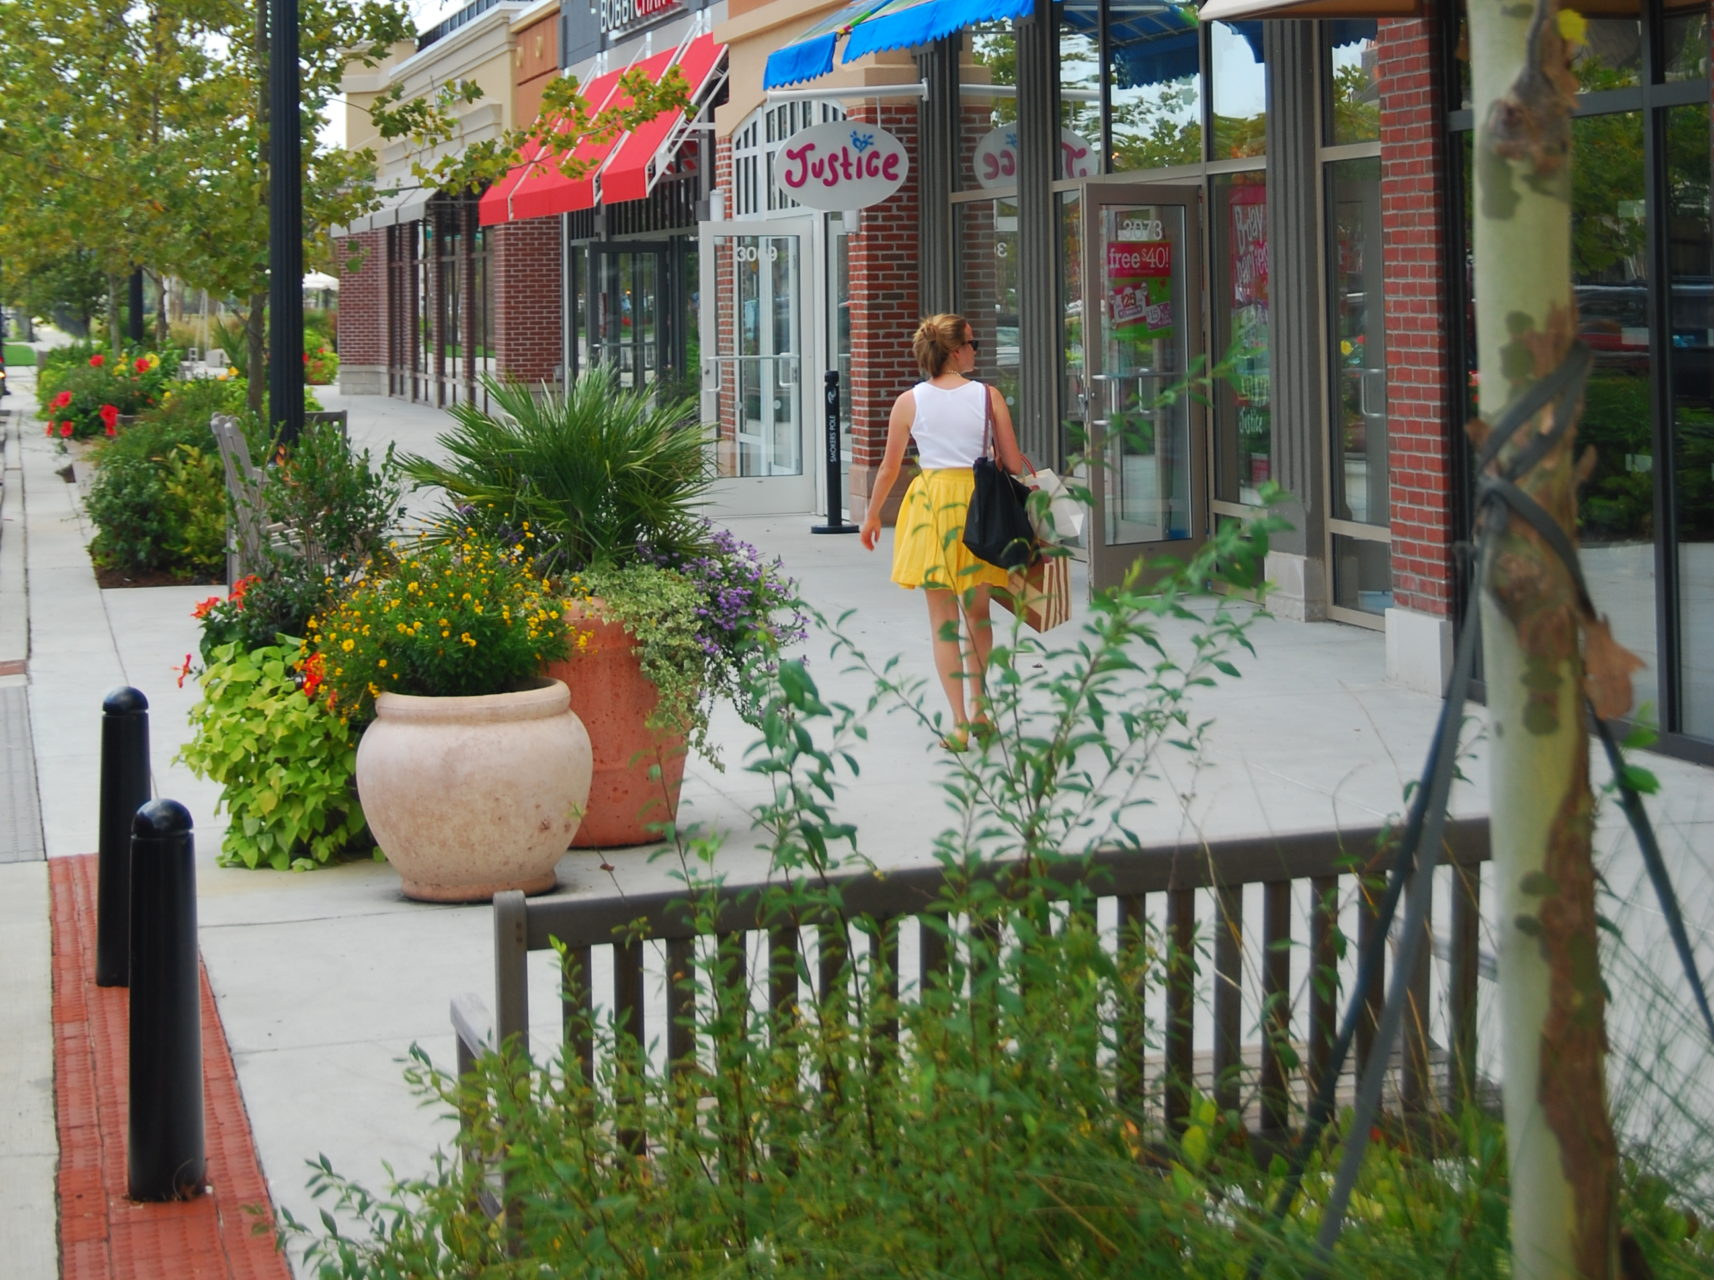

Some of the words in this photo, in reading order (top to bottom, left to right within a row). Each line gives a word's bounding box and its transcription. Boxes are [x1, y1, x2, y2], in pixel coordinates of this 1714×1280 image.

[785, 143, 899, 188] Justice
[1109, 248, 1140, 268] free
[1141, 247, 1169, 268] $40!
